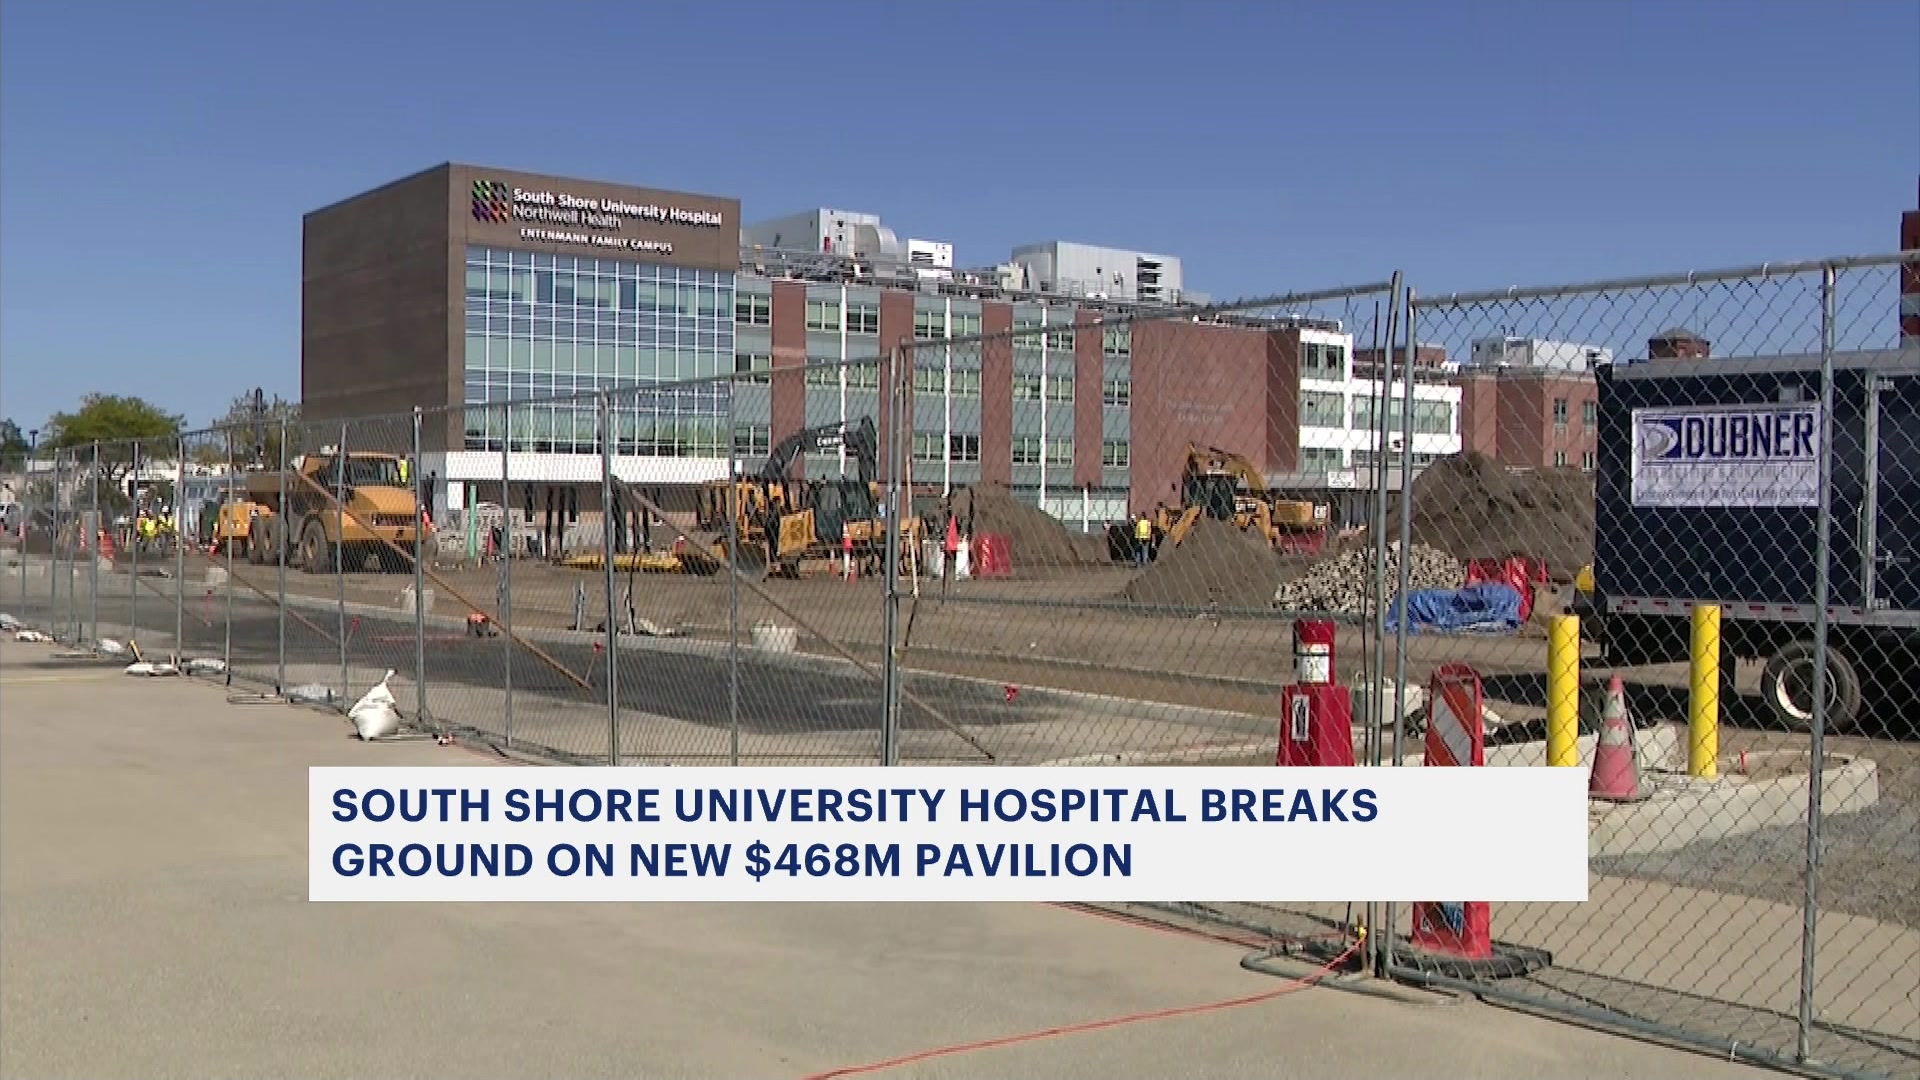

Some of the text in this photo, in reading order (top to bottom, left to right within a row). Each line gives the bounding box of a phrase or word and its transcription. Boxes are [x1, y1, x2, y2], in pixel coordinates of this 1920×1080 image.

[513, 188, 722, 226] South Shore University Hospital
[513, 204, 622, 228] Northwell Health
[521, 228, 672, 252] ENTENMANN FAMILY CAMPUS
[1686, 413, 1814, 459] DUBNER
